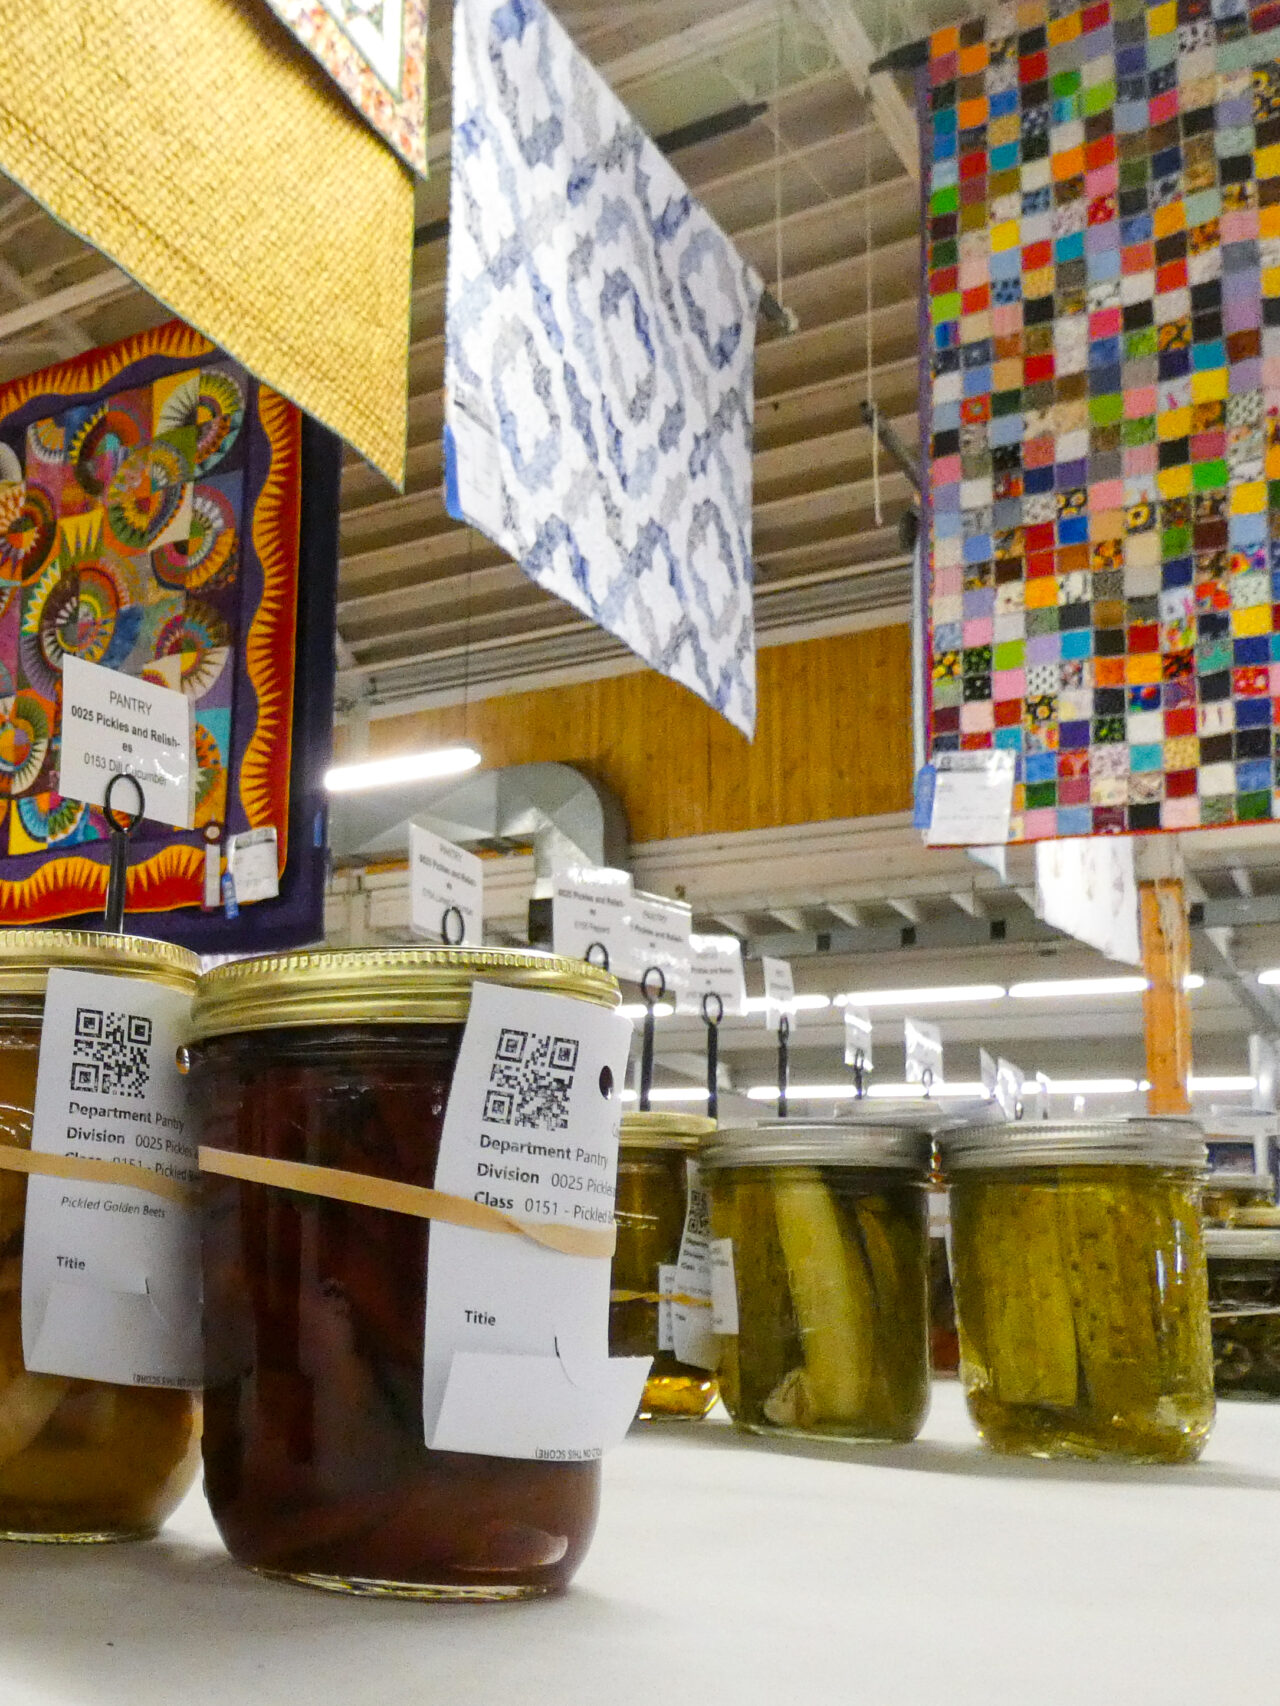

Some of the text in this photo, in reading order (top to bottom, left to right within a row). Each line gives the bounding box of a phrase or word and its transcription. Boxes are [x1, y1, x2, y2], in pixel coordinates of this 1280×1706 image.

[109, 690, 153, 716] PANTRY
[71, 705, 181, 748] 0025 Pickles and Relish-
[122, 742, 133, 753] es
[83, 752, 107, 769] 0153
[68, 1101, 185, 1135] Department Pantry
[66, 1126, 125, 1145] Division
[135, 1134, 163, 1150] 0025
[480, 1134, 609, 1171] Department Pantry
[477, 1162, 540, 1185] Division
[551, 1172, 583, 1191] 0025
[61, 1196, 101, 1211] Pickled
[103, 1200, 140, 1215] Golden
[474, 1190, 514, 1209] Class
[524, 1197, 558, 1216] 0151
[573, 1203, 608, 1223] Pickled
[56, 1255, 86, 1271] Title
[464, 1309, 497, 1327] Title
[535, 1447, 567, 1460] SCORE)
